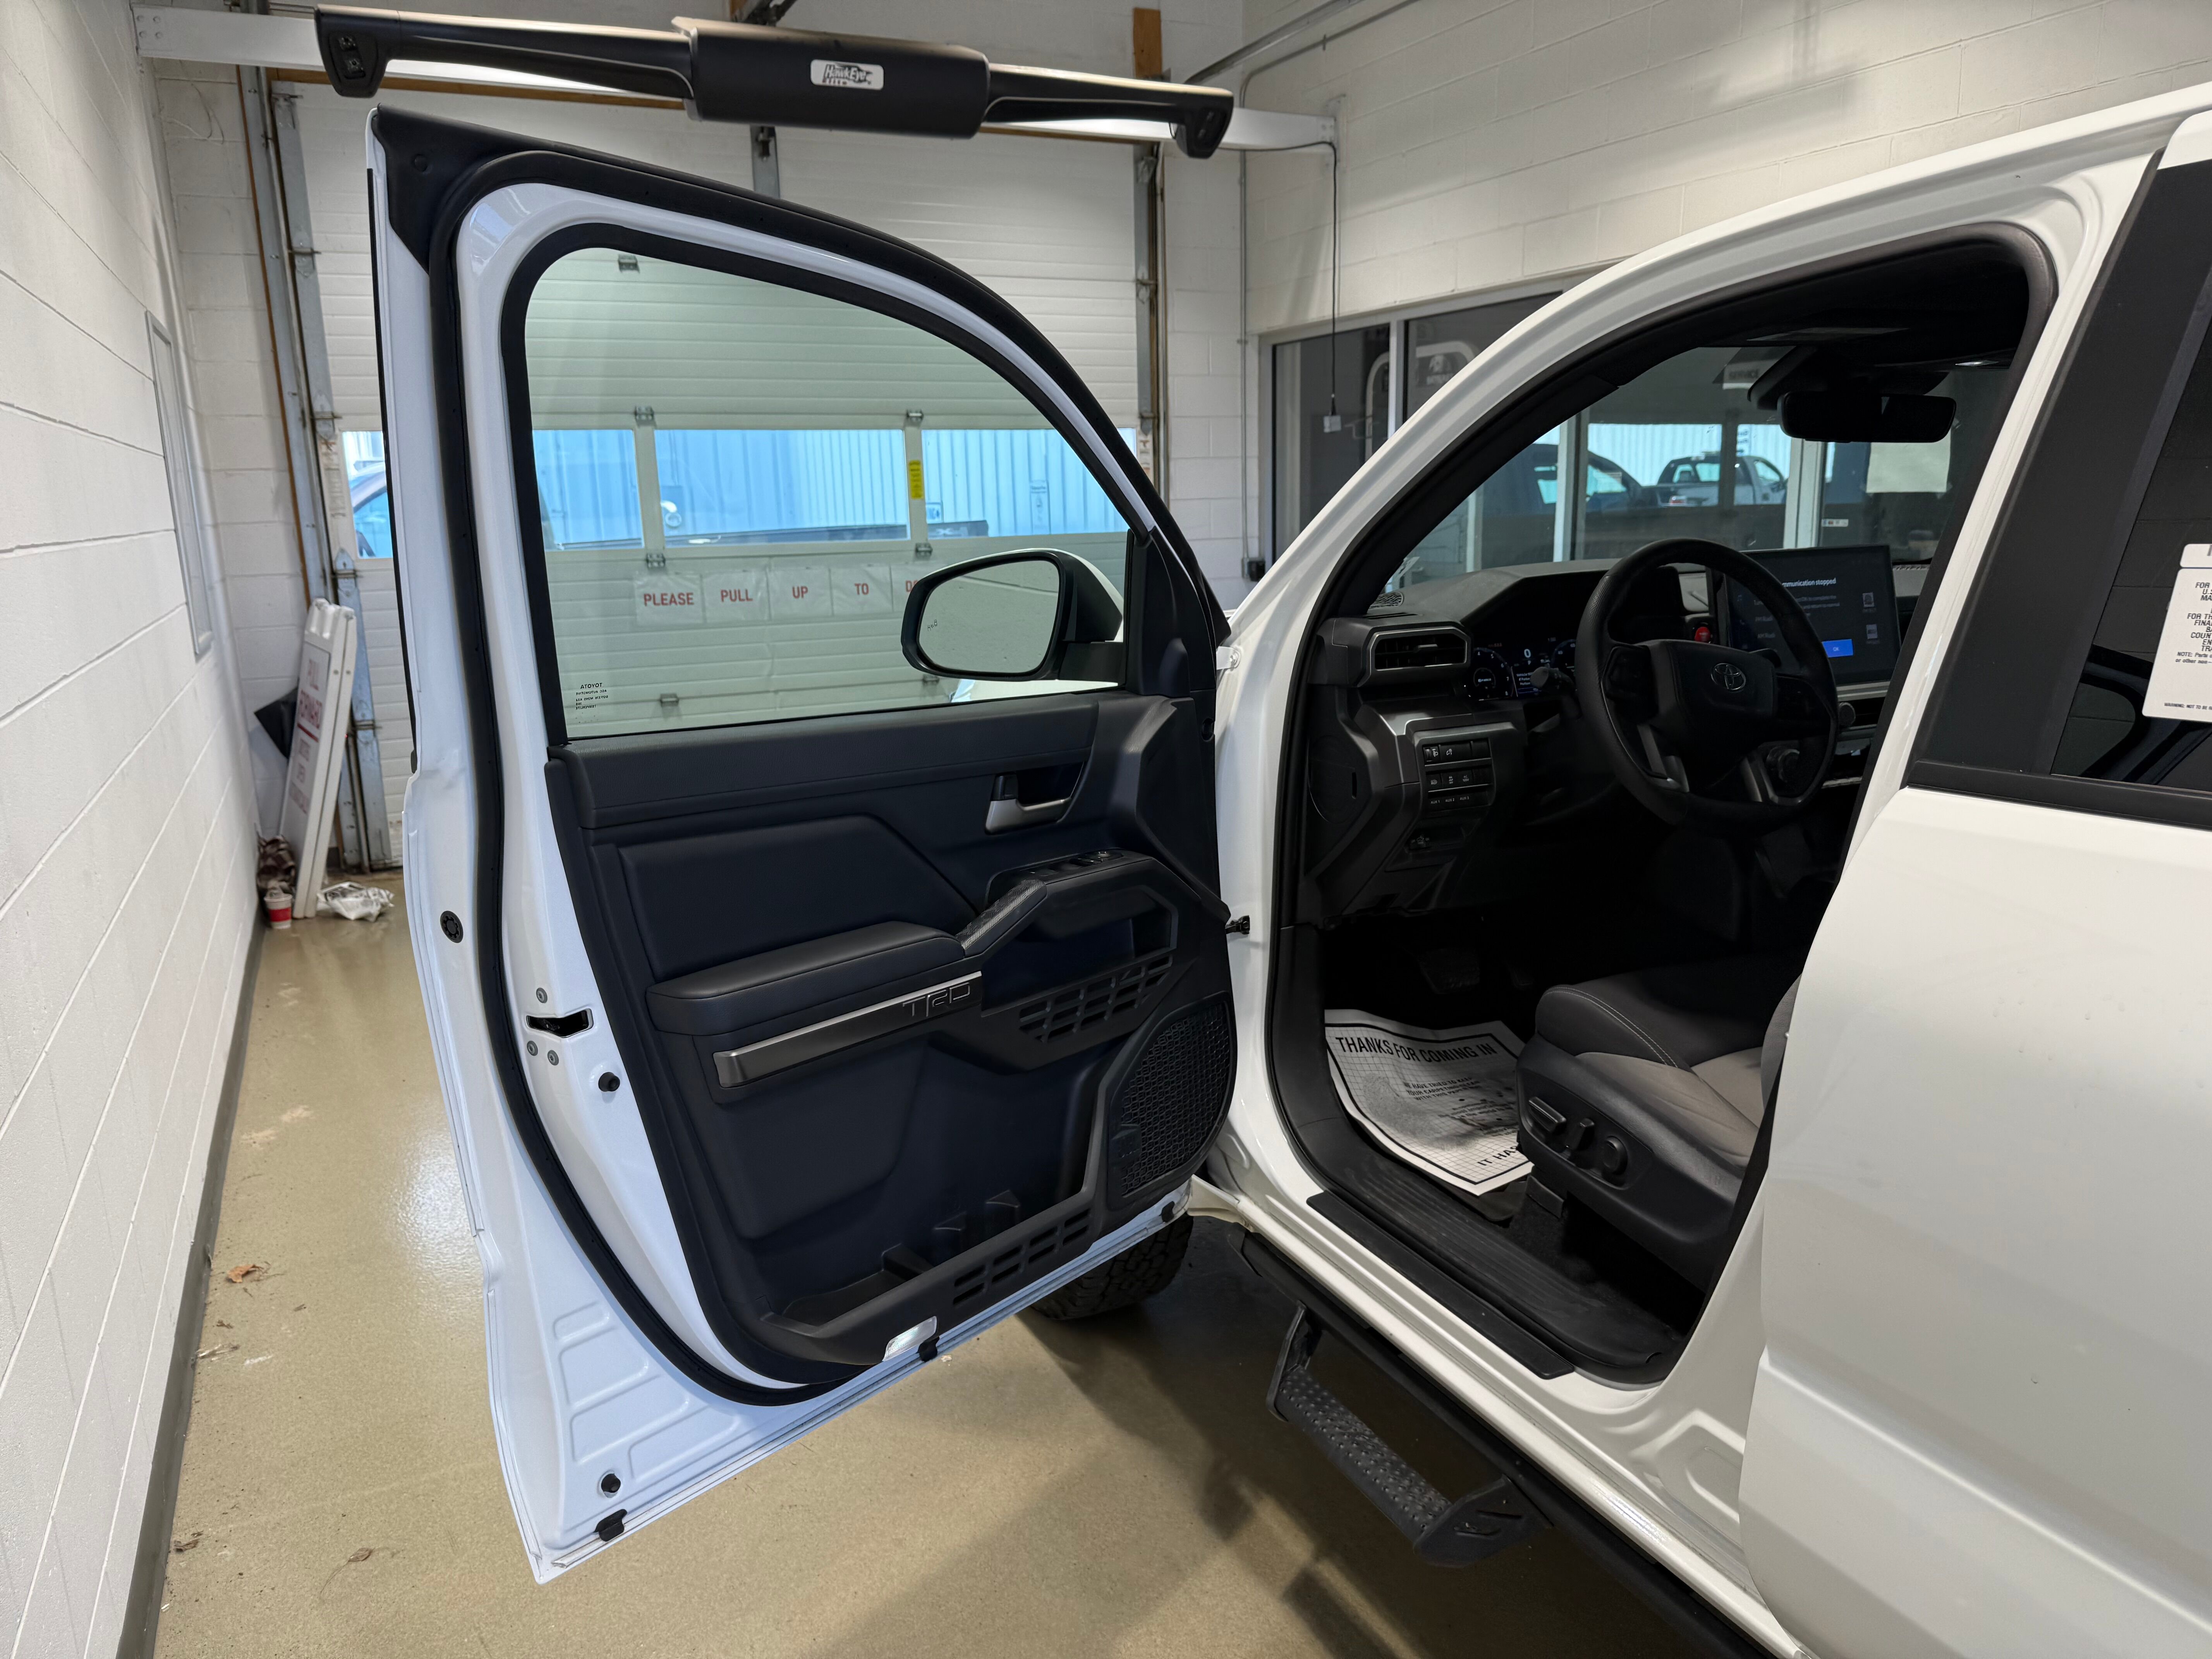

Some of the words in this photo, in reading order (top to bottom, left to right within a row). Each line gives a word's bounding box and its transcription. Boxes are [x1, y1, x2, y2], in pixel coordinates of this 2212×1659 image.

[1815, 577, 1836, 586] stopped
[644, 592, 694, 606] PLEASE
[721, 589, 753, 603] PULL
[792, 586, 808, 599] UP
[855, 583, 869, 596] TO
[1524, 649, 1531, 658] 0
[902, 981, 971, 1018] TRD
[1335, 1037, 1394, 1055] THANKS
[1393, 1042, 1420, 1061] FOR
[1419, 1046, 1479, 1063] COMING
[1476, 1043, 1498, 1055] IN
